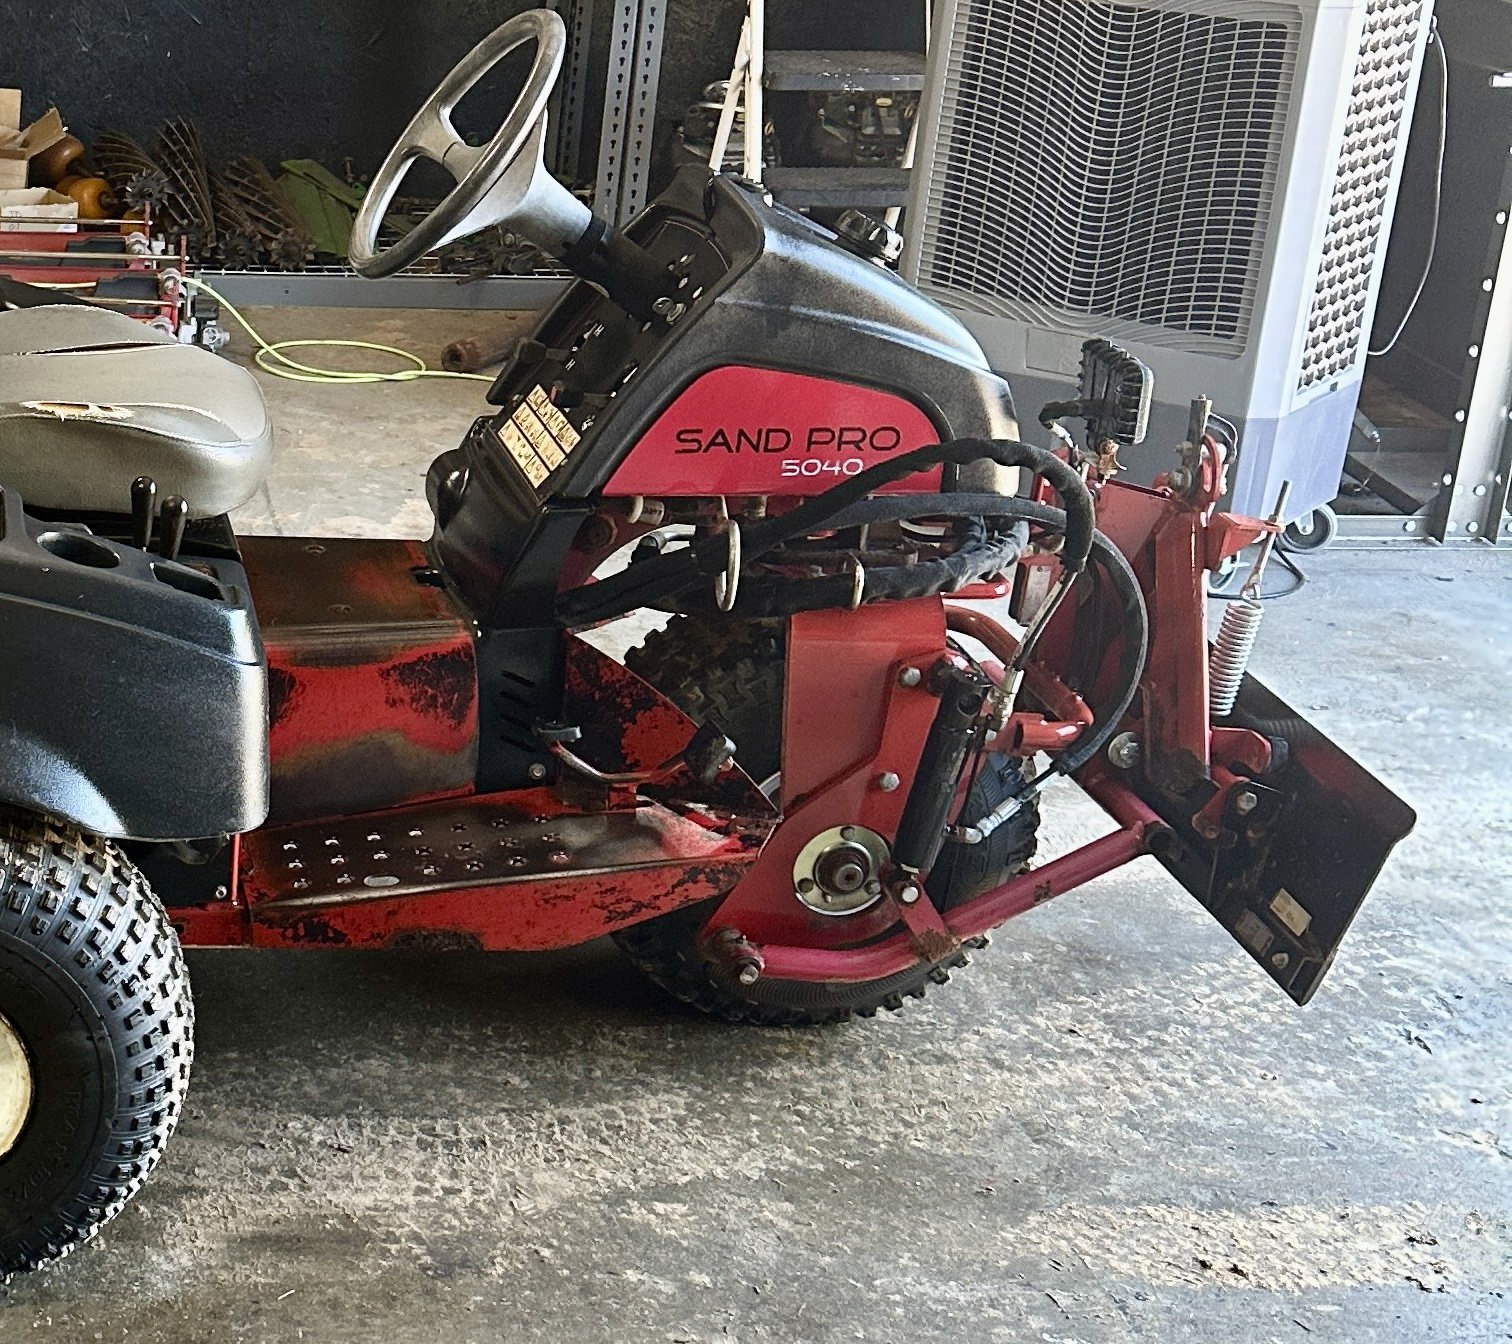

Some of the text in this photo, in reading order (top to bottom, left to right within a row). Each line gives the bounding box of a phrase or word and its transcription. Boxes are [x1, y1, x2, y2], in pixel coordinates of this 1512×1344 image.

[675, 426, 901, 453] SAND PRO
[781, 458, 864, 477] 5040
